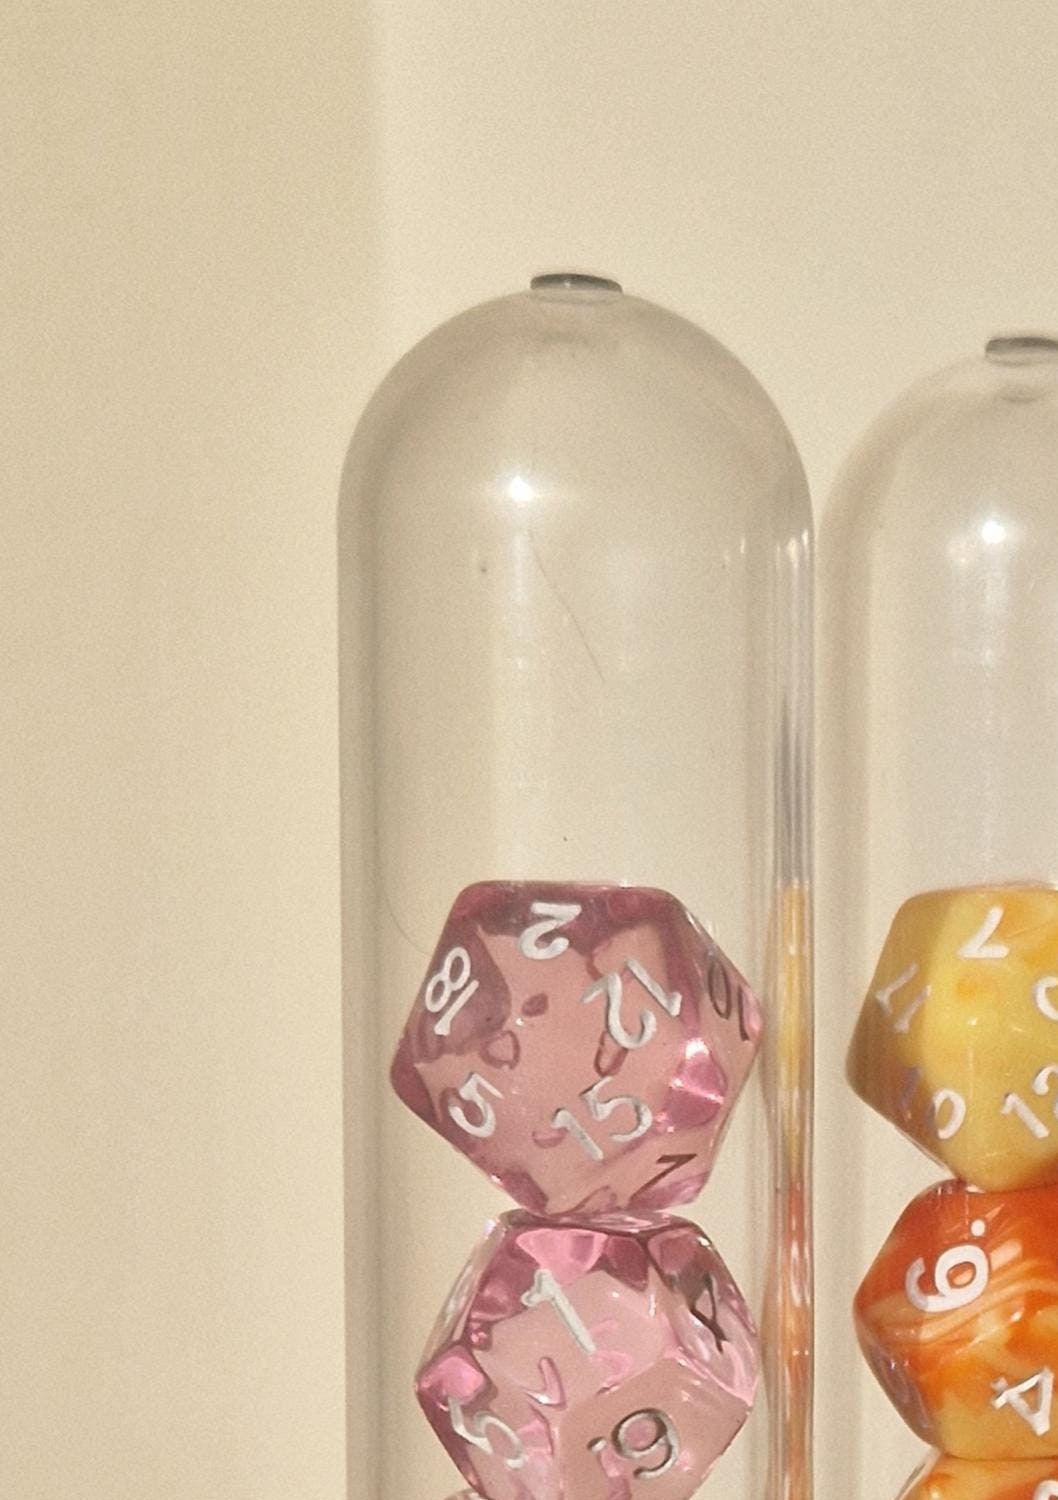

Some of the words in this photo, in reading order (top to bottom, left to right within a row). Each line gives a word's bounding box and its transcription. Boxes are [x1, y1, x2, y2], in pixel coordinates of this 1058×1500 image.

[519, 902, 581, 959] 2
[958, 906, 1010, 959] 7
[581, 958, 682, 1050] 12
[449, 1072, 503, 1138] 5
[552, 1075, 653, 1161] 15
[520, 1269, 598, 1355] 1
[990, 1367, 1055, 1437] 4
